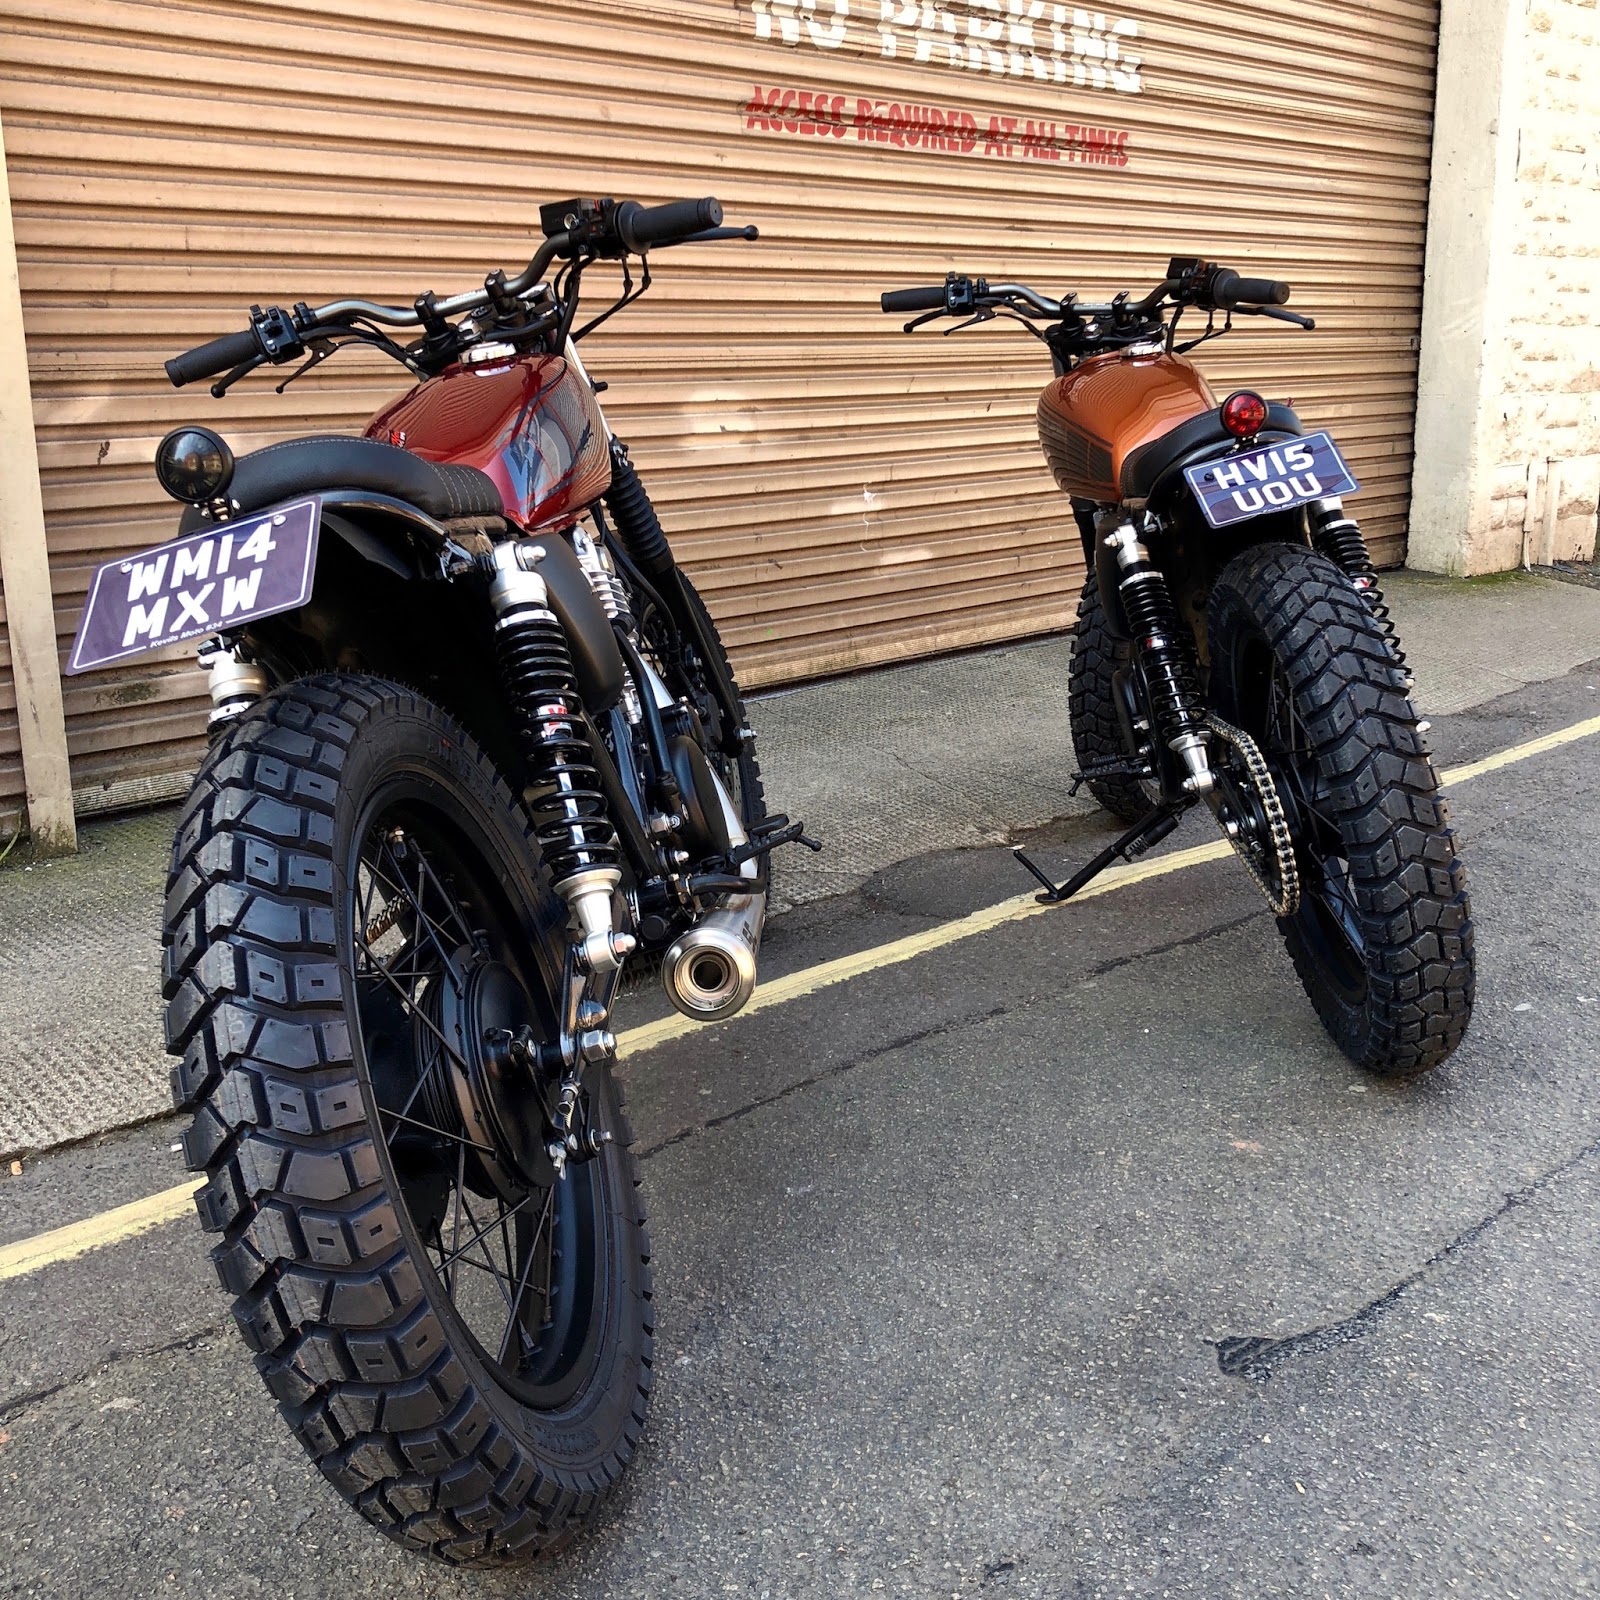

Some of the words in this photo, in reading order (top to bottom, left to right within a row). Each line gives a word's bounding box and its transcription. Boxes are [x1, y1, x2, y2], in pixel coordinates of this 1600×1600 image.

[751, 0, 848, 50] NO
[877, 0, 1143, 94] PARKING
[745, 86, 848, 138] ACCESS
[853, 99, 978, 153] REQUIRED
[984, 116, 1019, 157] AT
[1020, 120, 1061, 160] ALL
[1064, 125, 1129, 167] TIMES
[1211, 443, 1315, 490] HV15
[1231, 472, 1323, 512] UOU
[127, 522, 277, 602] WM14
[121, 568, 263, 648] MXW
